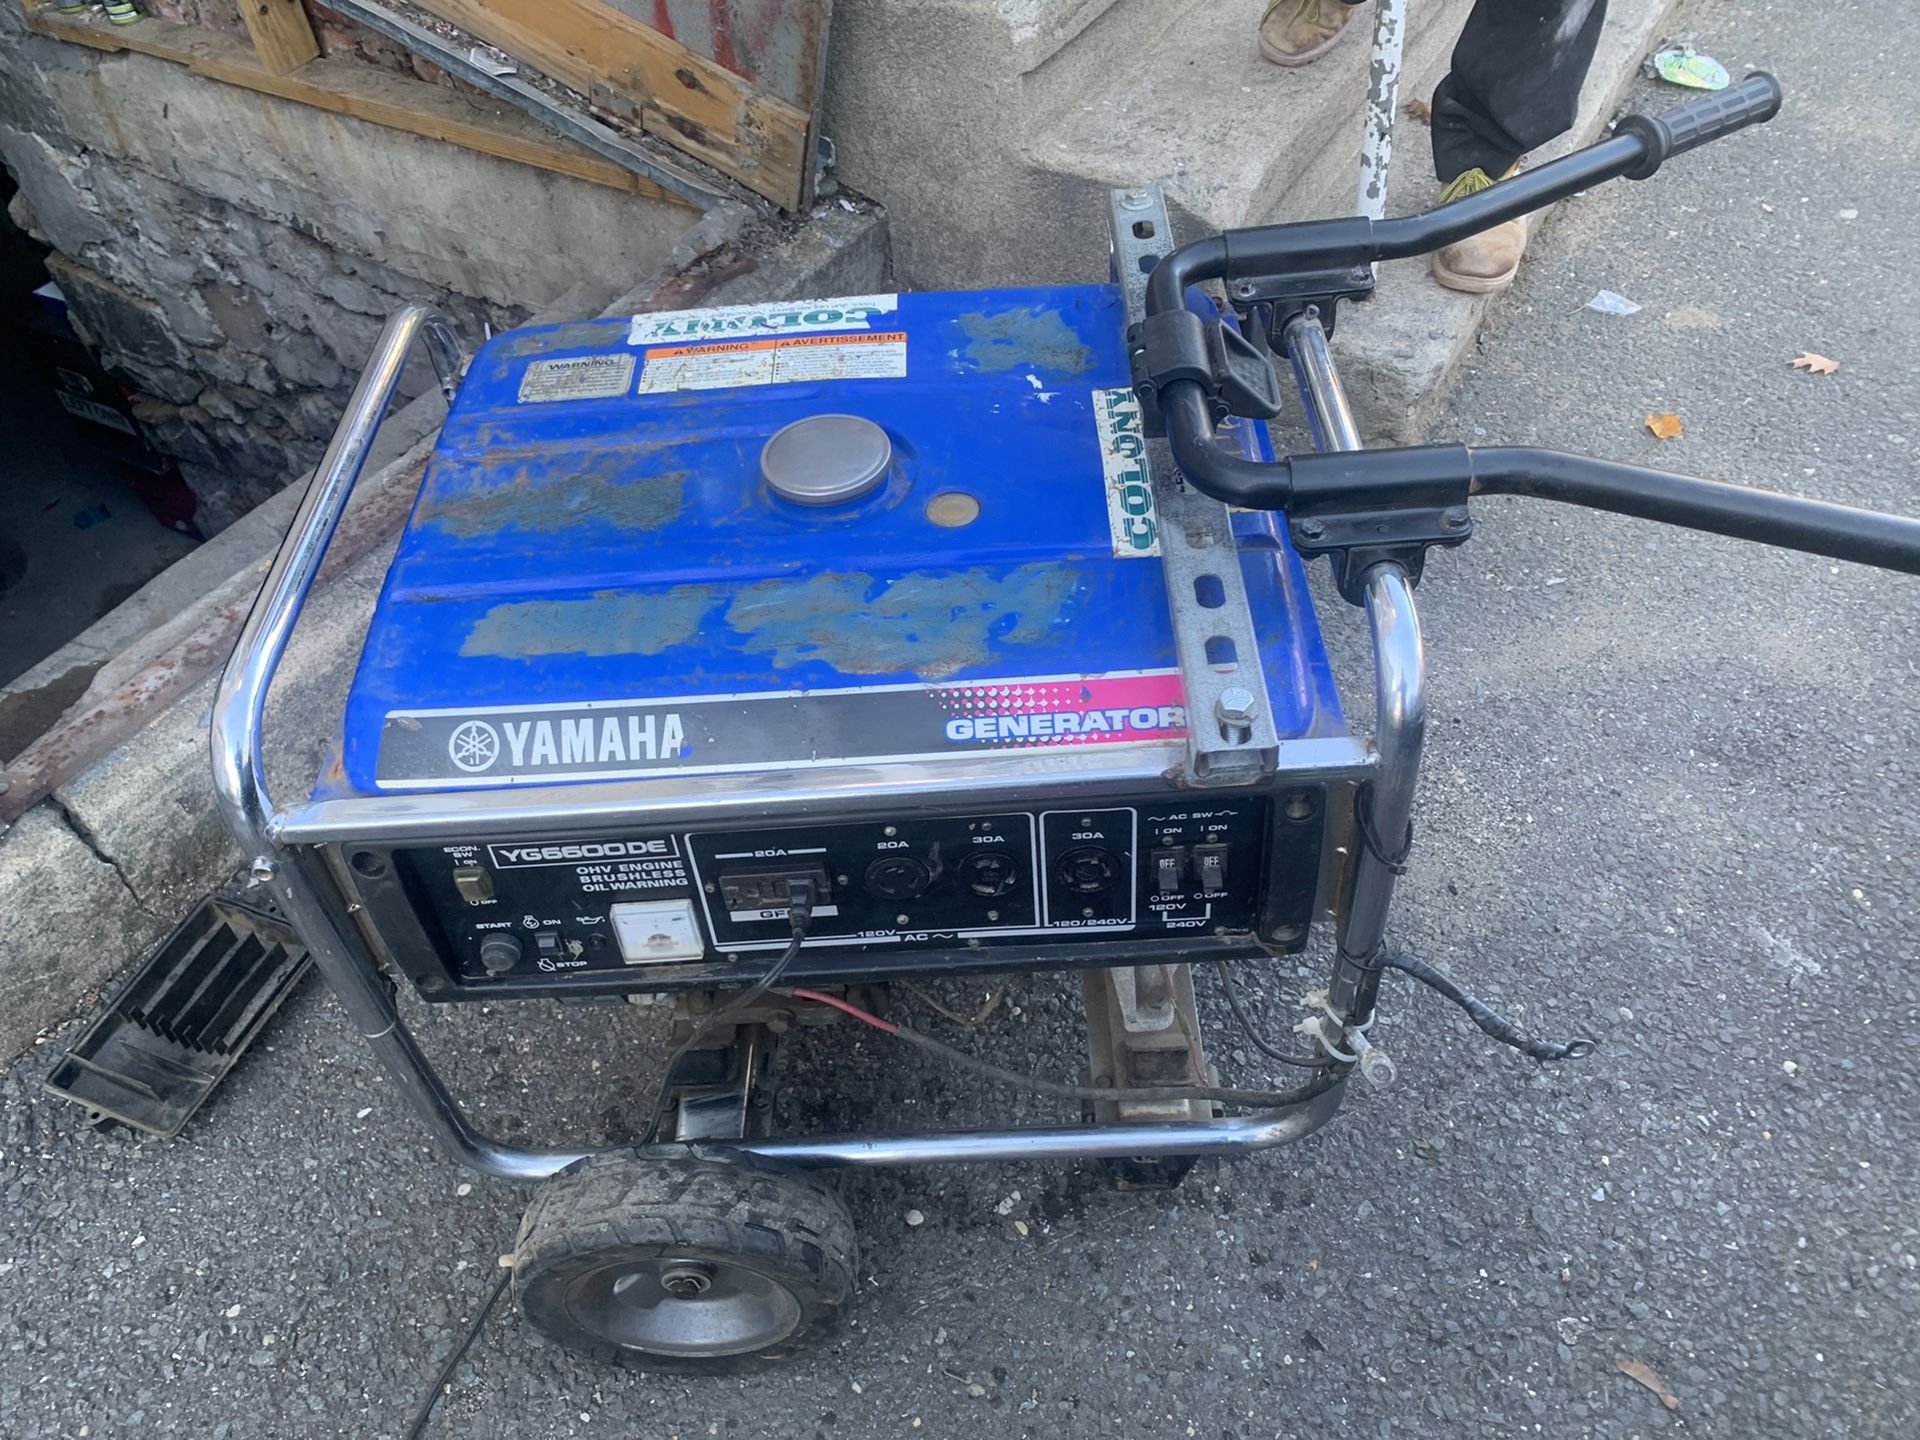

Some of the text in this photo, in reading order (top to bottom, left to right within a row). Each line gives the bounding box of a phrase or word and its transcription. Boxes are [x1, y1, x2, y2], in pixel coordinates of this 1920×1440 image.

[793, 333, 905, 346] AVERTISSEMENT
[686, 343, 749, 354] WARNING
[549, 359, 614, 370] WARNING
[1104, 389, 1158, 550] COLONY
[945, 706, 1187, 742] GENERATOR
[503, 712, 684, 766] YAMAHA
[1169, 811, 1213, 821] AC SW
[972, 835, 1005, 844] 30A
[1072, 832, 1104, 840] 30A
[500, 839, 668, 862] YG6600DE
[876, 840, 909, 850] 20A
[754, 849, 787, 858] 20A
[1160, 858, 1175, 869] OFF
[1203, 856, 1219, 867] OFF
[576, 860, 683, 875] OHV ENGINE
[579, 869, 686, 883] BRUSHLESS
[582, 878, 689, 892] OIL WARNING
[1148, 902, 1187, 911] 120V
[475, 921, 512, 929] START
[1052, 918, 1128, 927] 120/240V
[1166, 920, 1207, 928] 240V
[857, 929, 929, 942] 120V AC
[556, 960, 588, 968] STOP
